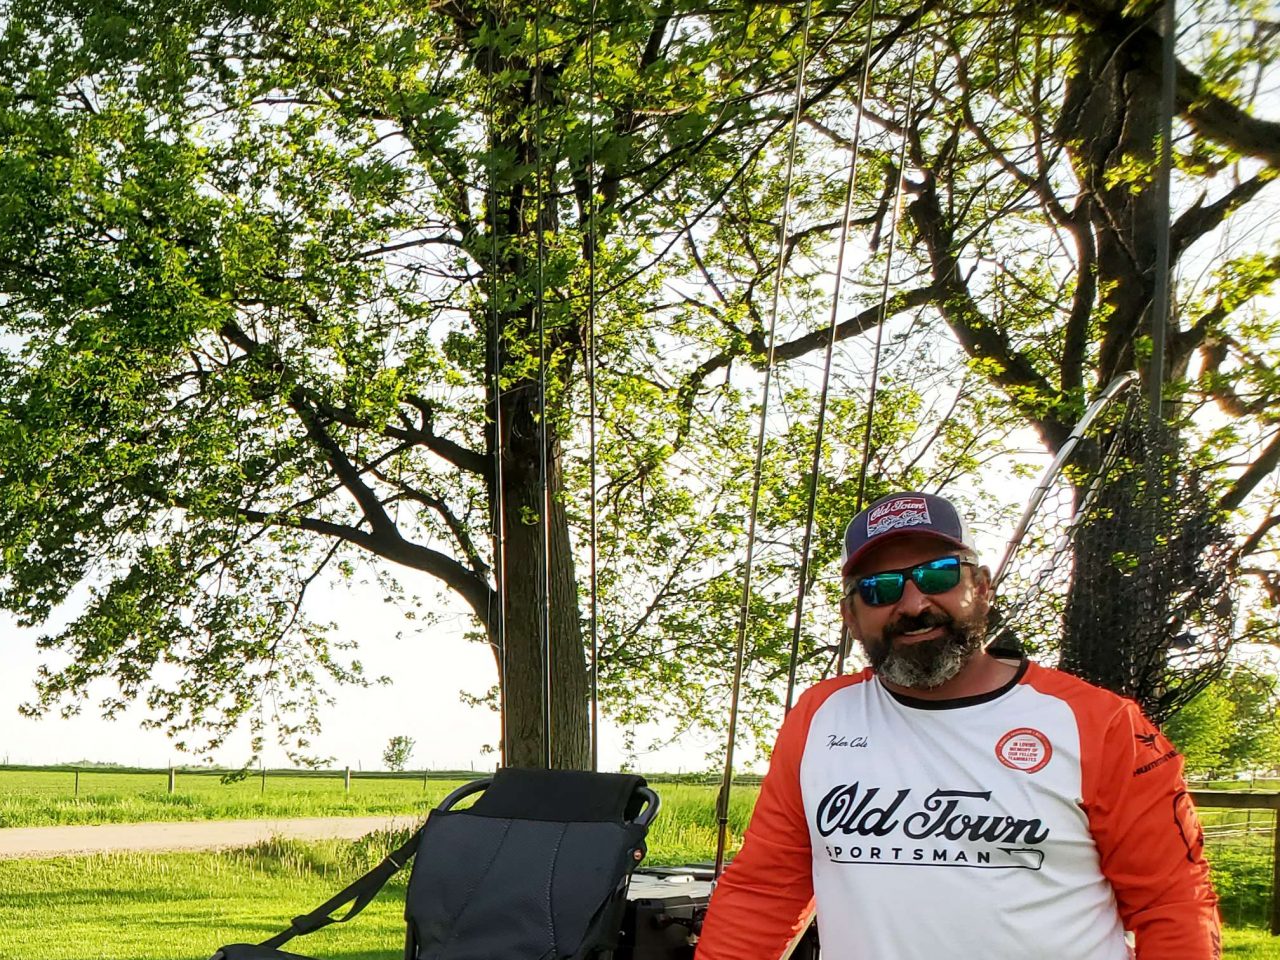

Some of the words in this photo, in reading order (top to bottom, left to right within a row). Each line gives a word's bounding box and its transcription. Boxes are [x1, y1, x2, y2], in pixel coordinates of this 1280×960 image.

[816, 781, 912, 838] Old
[903, 788, 1050, 845] Town
[825, 846, 991, 864] SPORTSMAN
